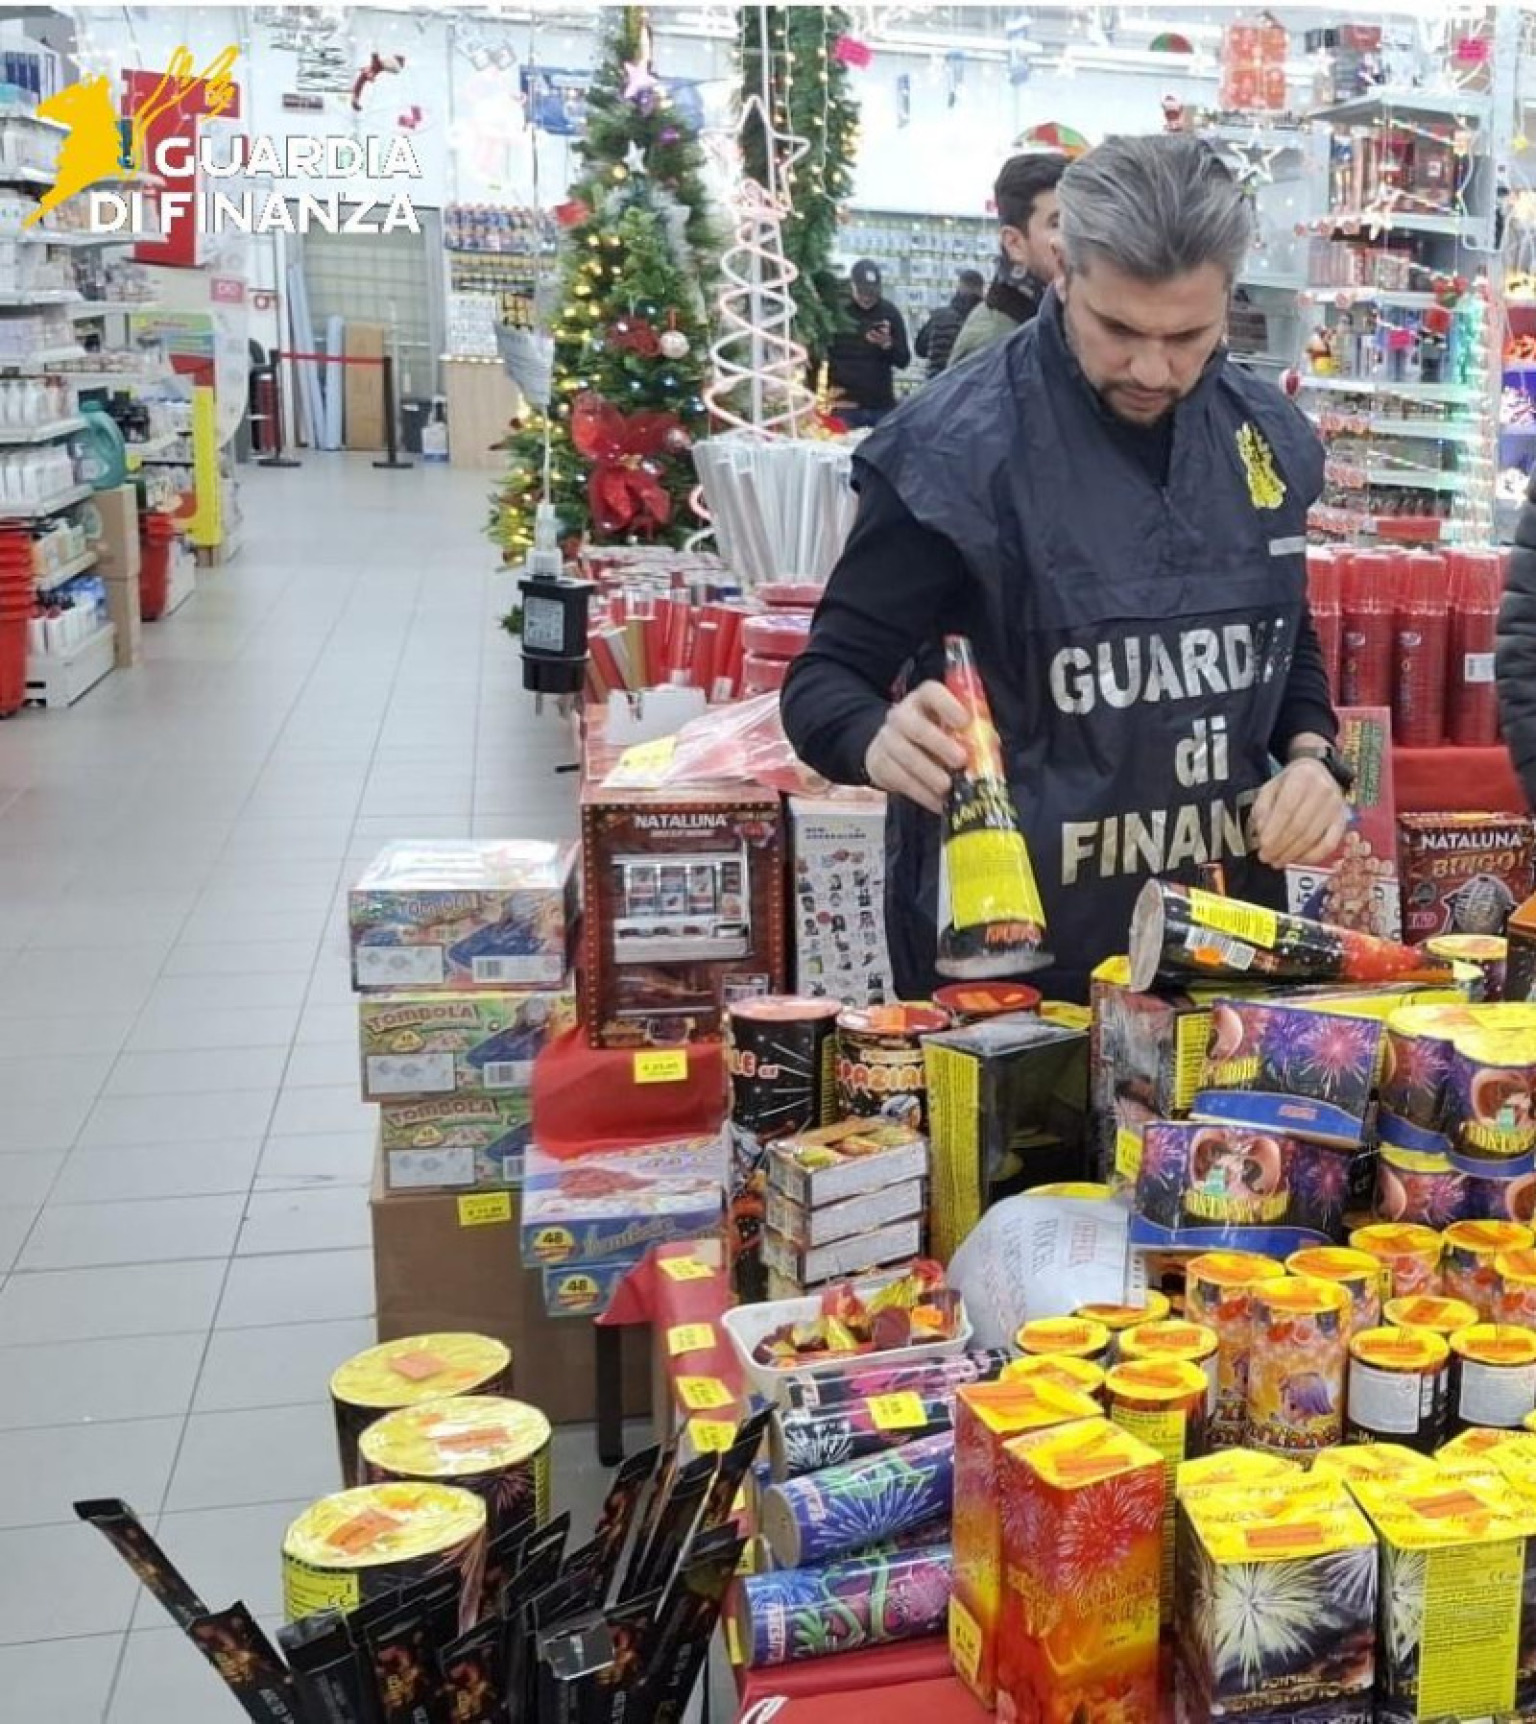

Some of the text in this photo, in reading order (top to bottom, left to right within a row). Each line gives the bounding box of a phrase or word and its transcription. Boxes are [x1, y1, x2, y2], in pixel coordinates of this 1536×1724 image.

[1048, 617, 1292, 716] GUARD
[1174, 716, 1229, 787] di
[633, 813, 730, 829] NATALUNA
[1060, 788, 1256, 886] FINAN
[1420, 831, 1524, 850] NATALUNA
[1431, 851, 1526, 878] BINGO!
[368, 1003, 476, 1027] TOMBOLA
[388, 1099, 494, 1121] TOMBOLA
[542, 1231, 564, 1244] 48
[567, 1279, 589, 1291] 48
